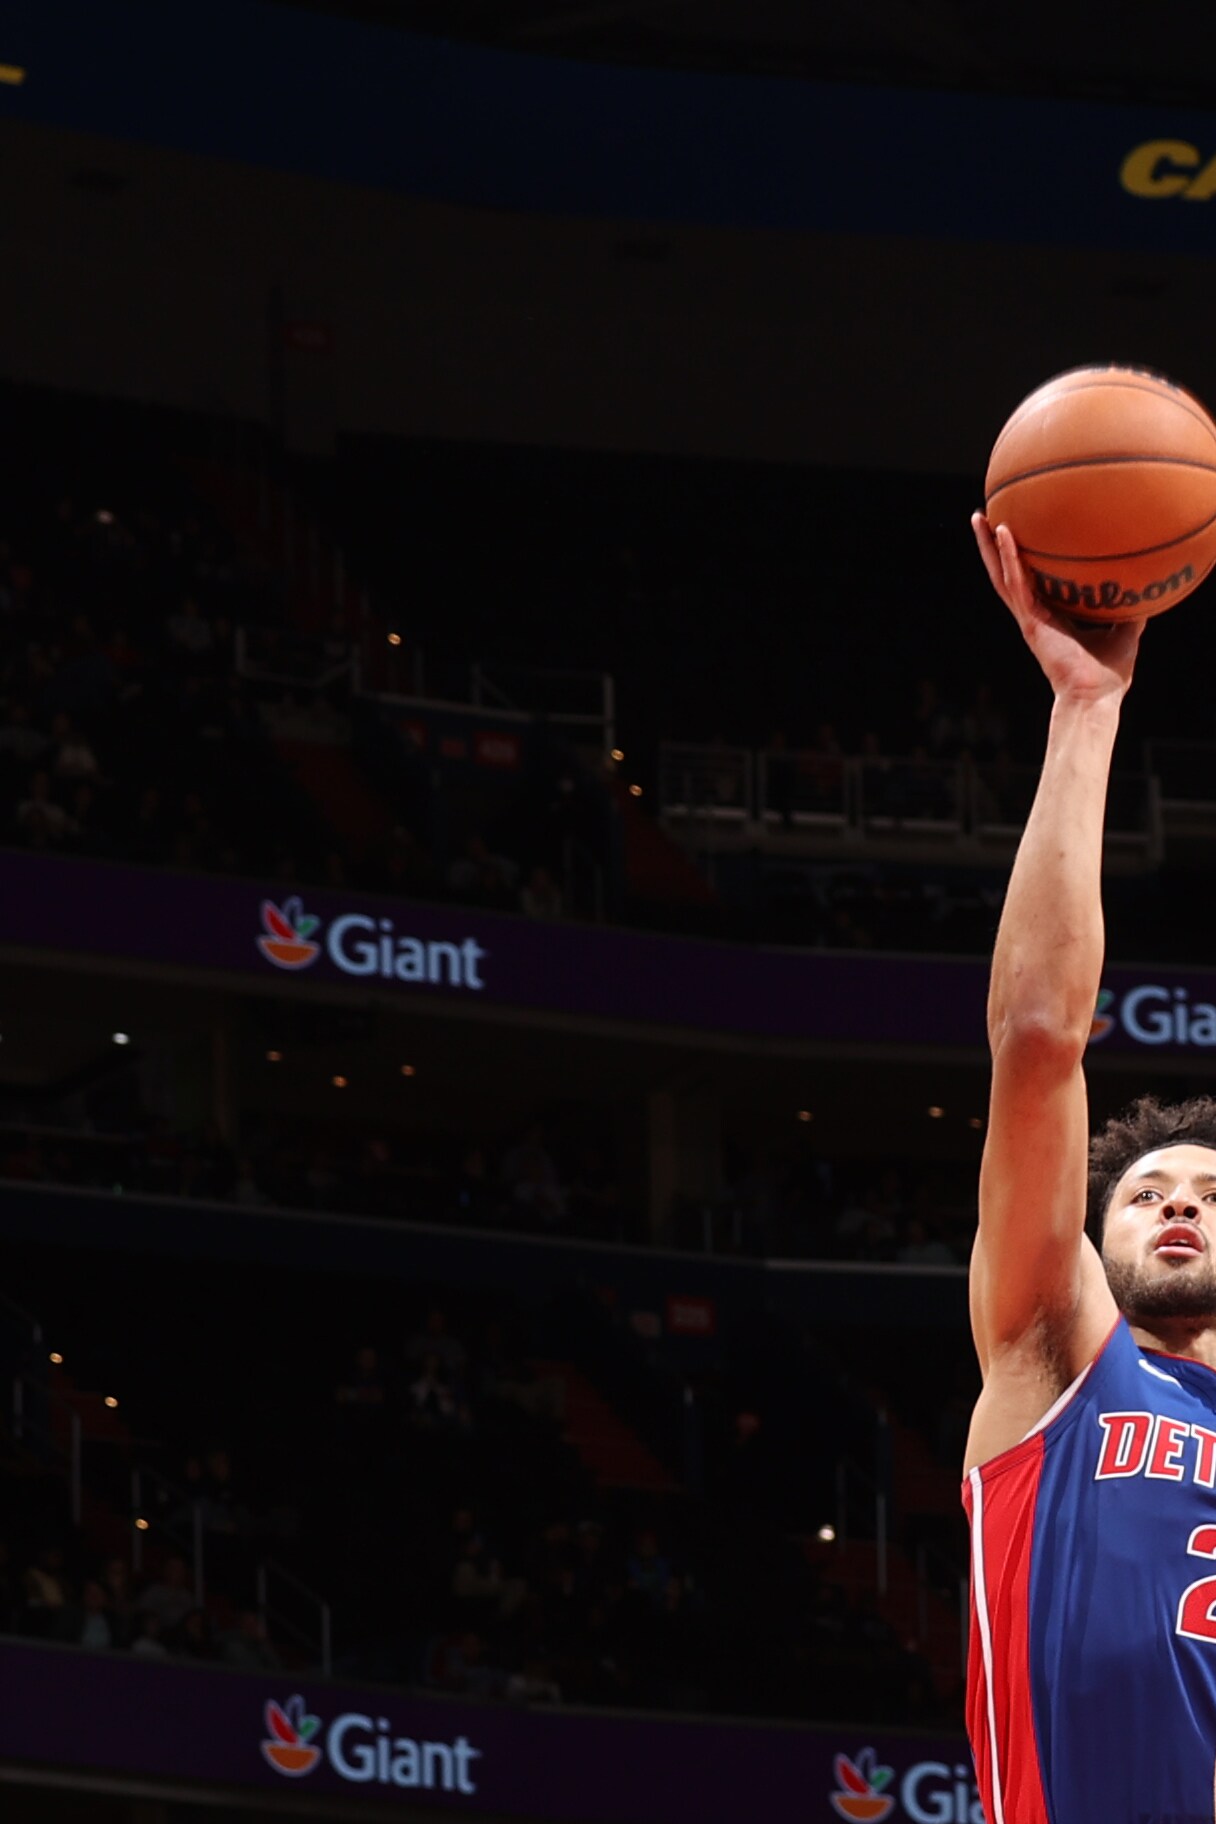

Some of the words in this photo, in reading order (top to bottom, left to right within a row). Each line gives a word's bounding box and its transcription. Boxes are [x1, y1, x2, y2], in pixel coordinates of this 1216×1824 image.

[1031, 563, 1195, 609] Wilson
[325, 912, 486, 992] Giant
[325, 1711, 482, 1797] Giant
